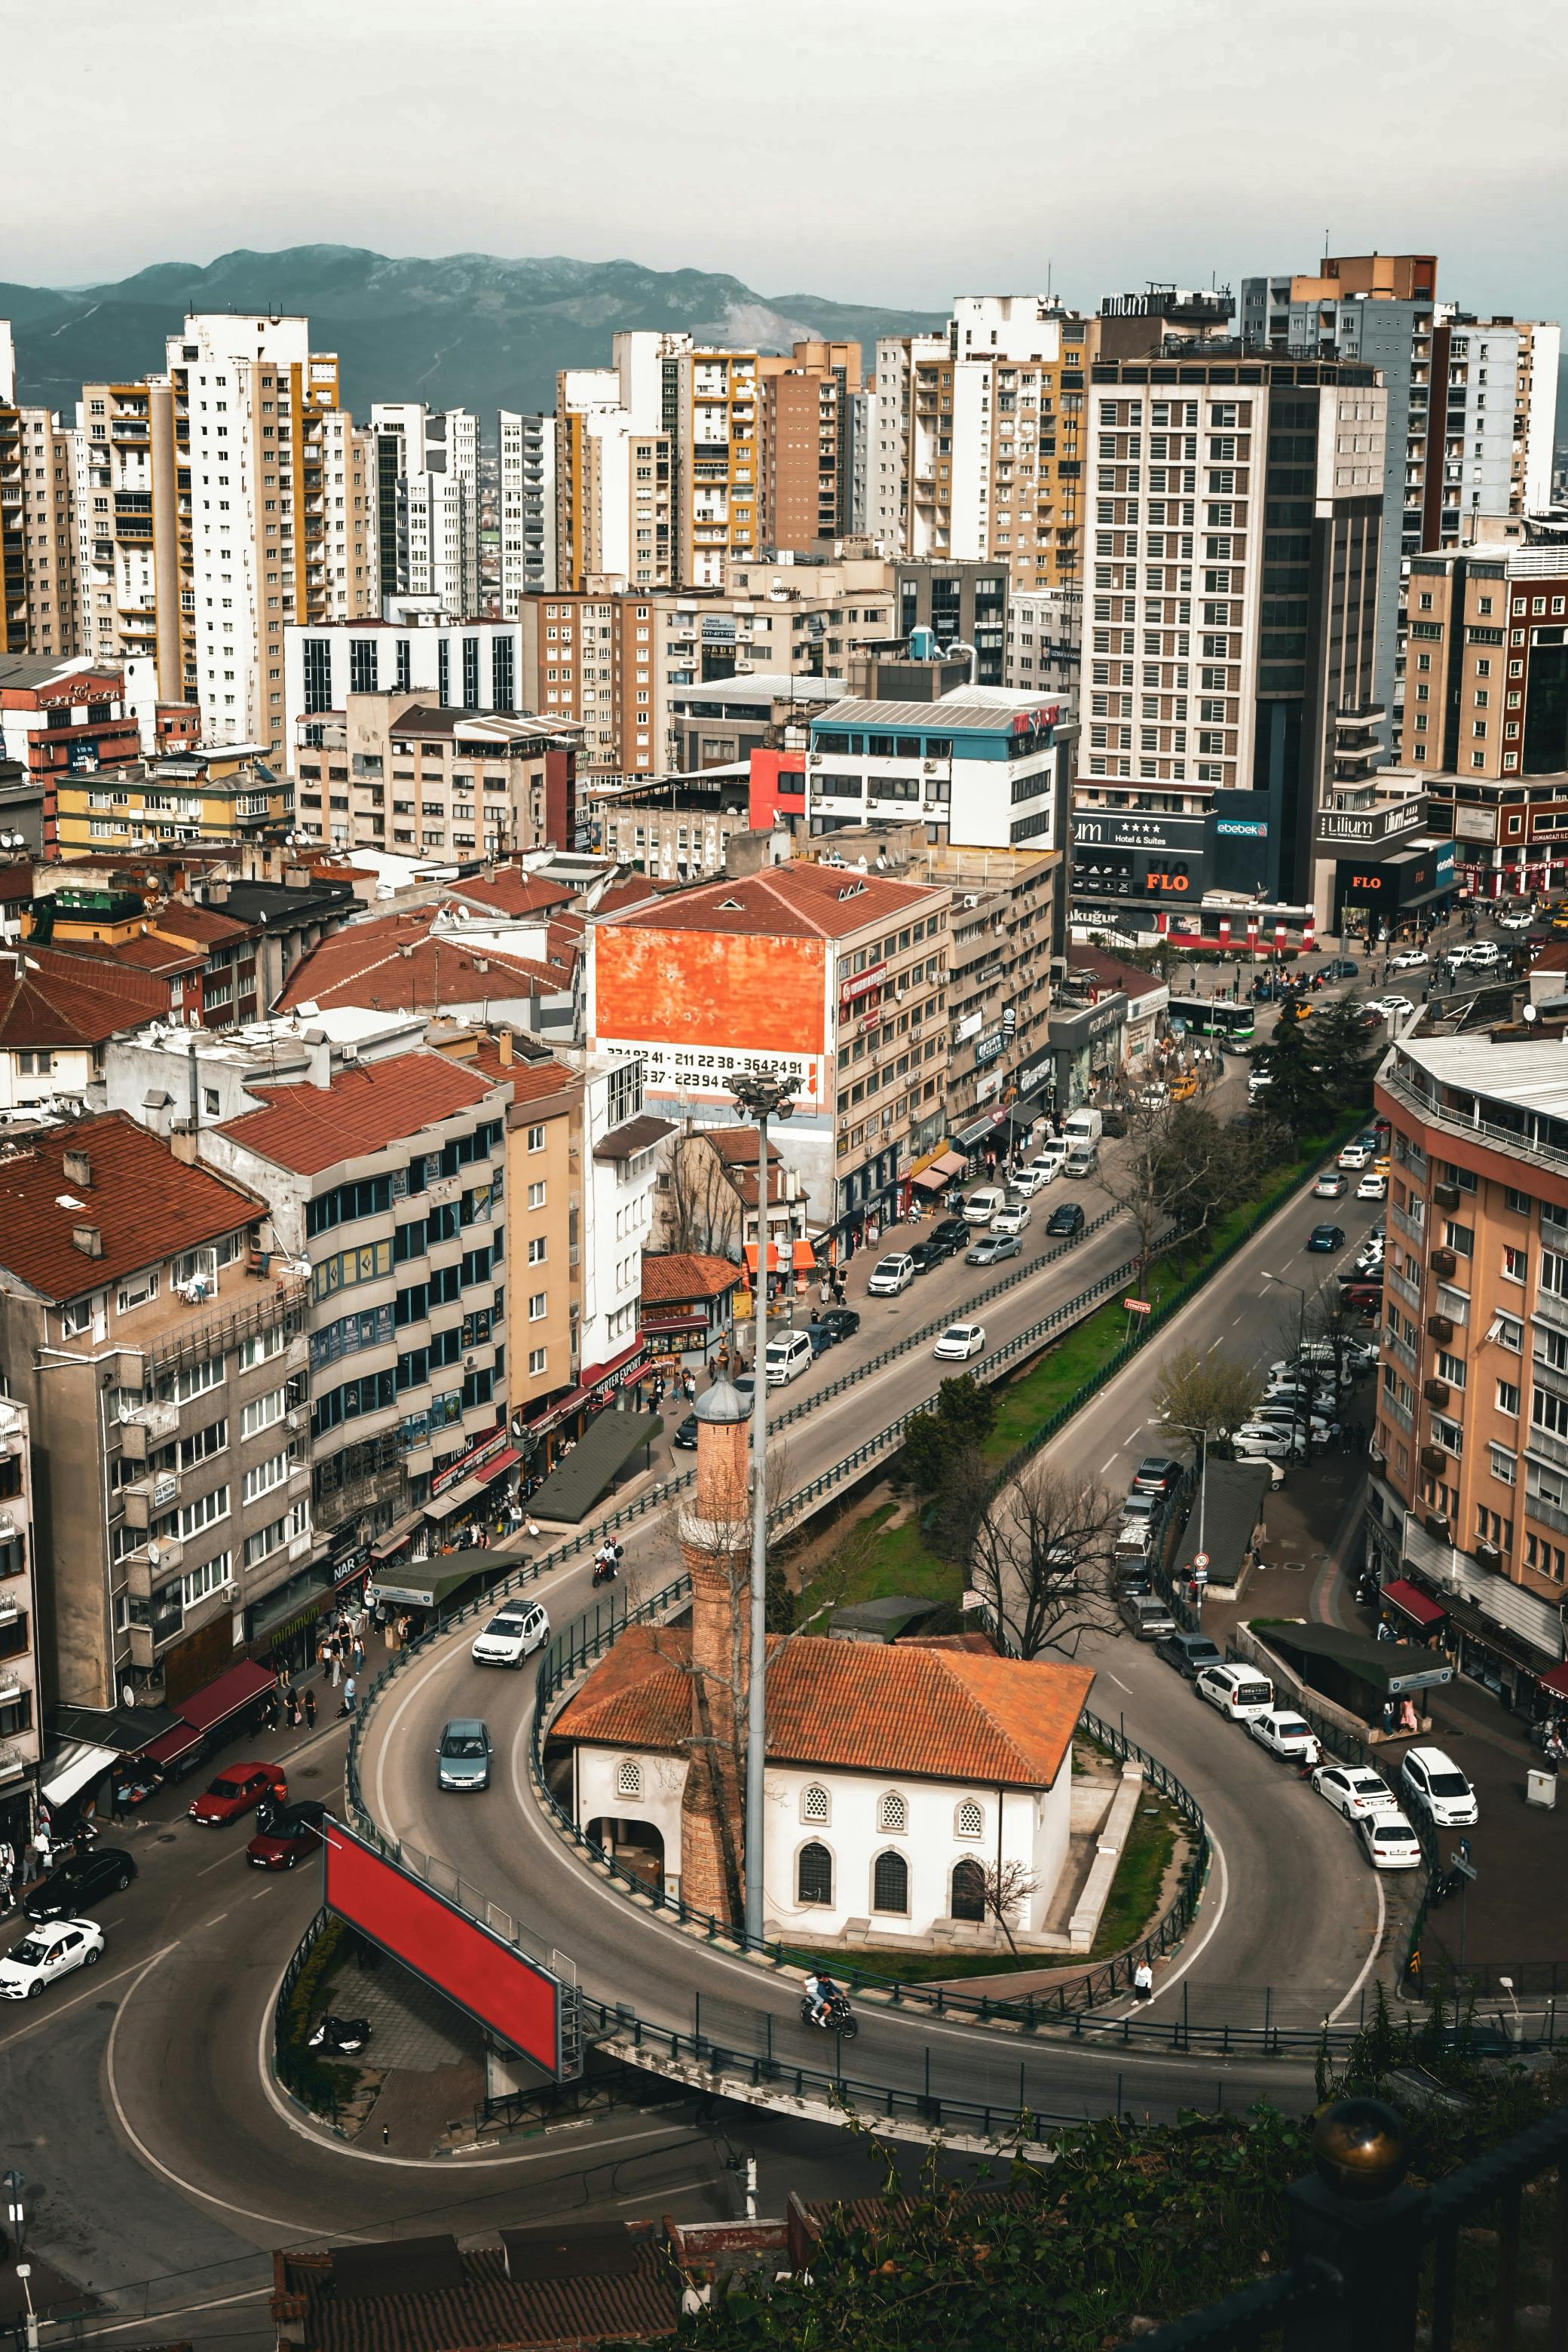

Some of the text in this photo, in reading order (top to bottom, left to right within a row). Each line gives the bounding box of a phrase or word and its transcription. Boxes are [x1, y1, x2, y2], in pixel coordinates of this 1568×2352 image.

[1100, 292, 1148, 316] Lilium
[1217, 823, 1257, 835] ebebek
[1328, 816, 1372, 835] Lilium
[1115, 835, 1135, 843] Hotel
[1143, 837, 1166, 845] Suites
[1455, 862, 1485, 872] CZANE
[1514, 861, 1565, 872] ECZANE
[1147, 874, 1189, 891] FLO
[1352, 876, 1381, 890] FLO
[651, 1052, 663, 1064] 41
[675, 1053, 694, 1067] 211
[698, 1055, 715, 1067] 22
[718, 1056, 733, 1069] 38
[744, 1058, 768, 1072] 364
[771, 1060, 787, 1073] 24
[789, 1061, 802, 1074] 91
[651, 1071, 666, 1083] 37
[675, 1072, 700, 1086] 223
[702, 1073, 718, 1087] 94
[620, 1355, 642, 1381] EXPORT
[333, 1557, 355, 1581] NAR
[272, 1605, 319, 1649] minimum
